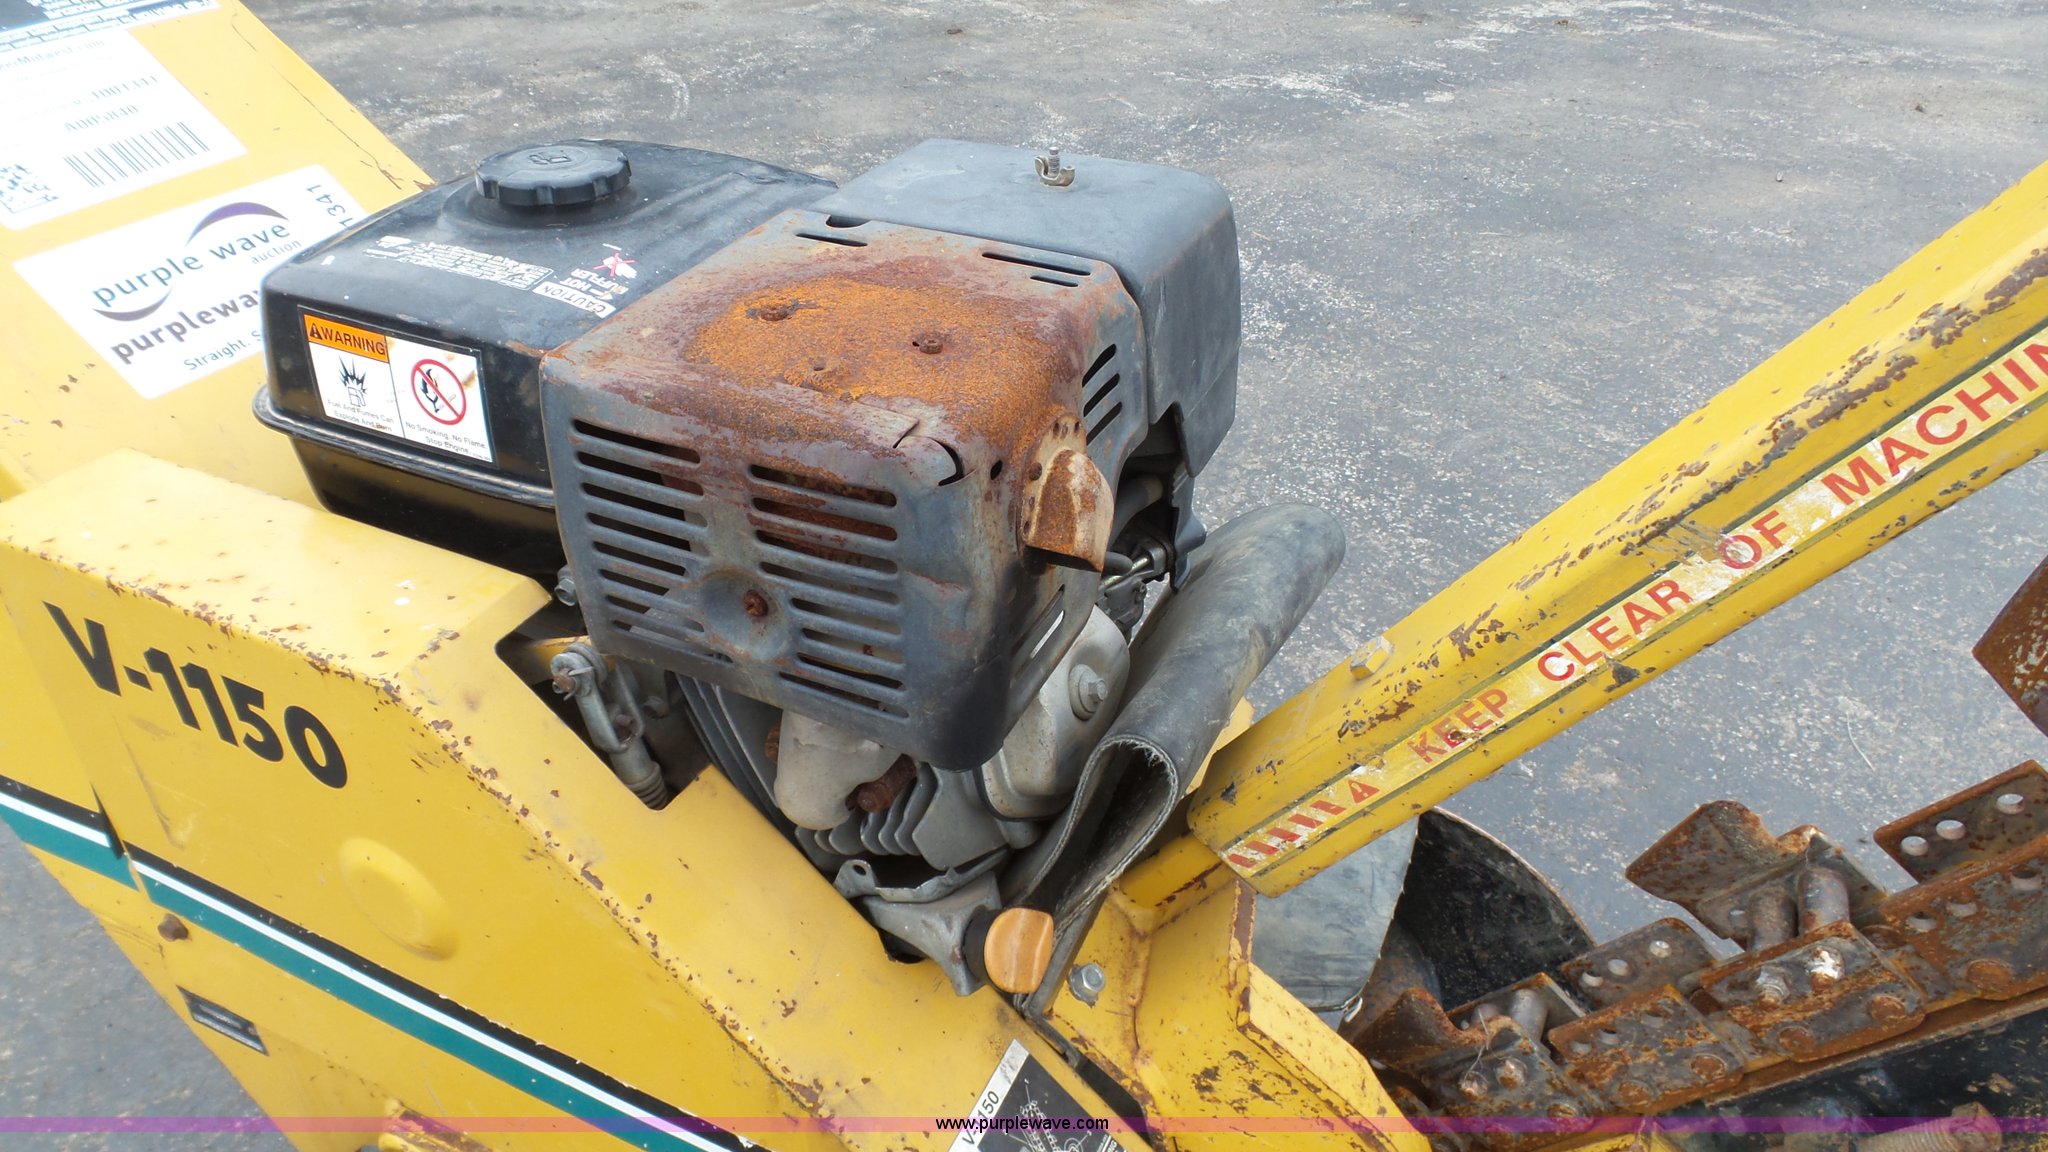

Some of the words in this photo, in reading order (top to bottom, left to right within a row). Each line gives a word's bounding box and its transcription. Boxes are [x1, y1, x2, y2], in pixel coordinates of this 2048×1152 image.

[92, 257, 203, 307] purple
[209, 223, 290, 260] wave
[252, 239, 302, 265] auction
[110, 289, 260, 366] purplewa
[542, 284, 607, 314] CAUTION
[320, 325, 387, 357] WARNING
[1407, 687, 1509, 764] KEEP
[1537, 578, 1695, 682] CLEAR
[1717, 509, 1788, 570] OF
[41, 600, 348, 789] V-1150
